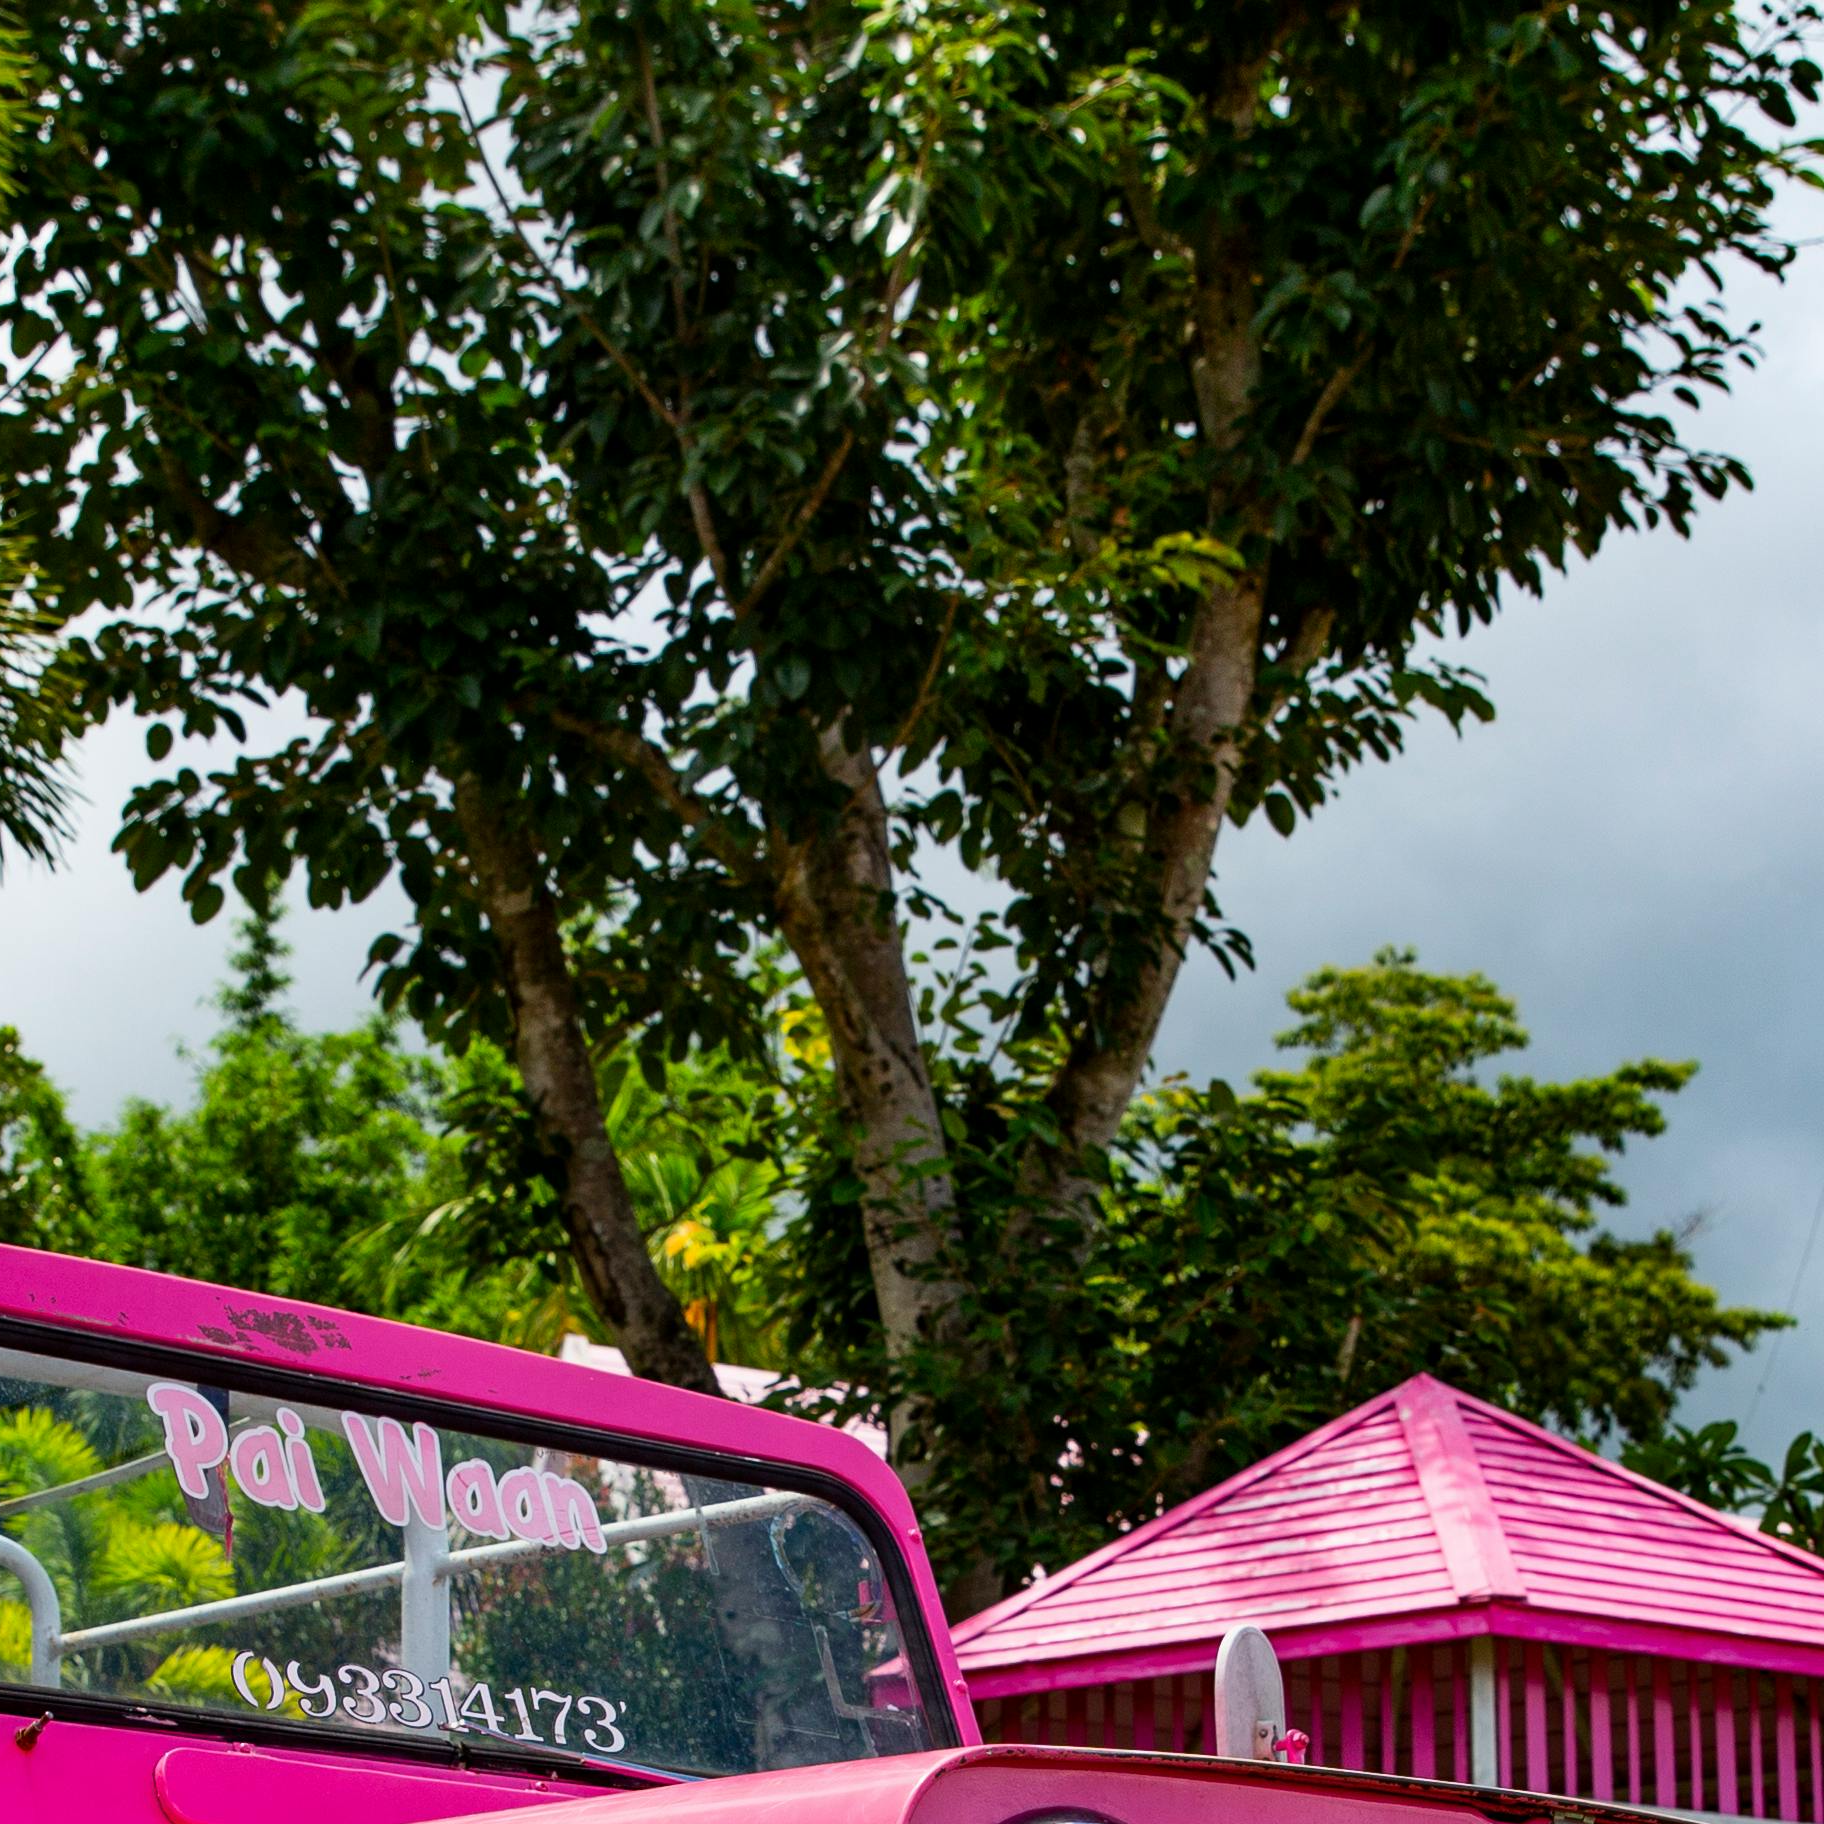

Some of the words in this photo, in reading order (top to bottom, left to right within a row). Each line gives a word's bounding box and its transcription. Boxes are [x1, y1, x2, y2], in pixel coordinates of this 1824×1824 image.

[147, 1381, 326, 1513] Pai
[341, 1410, 608, 1555] Waan
[231, 1649, 627, 1753] 093314173
